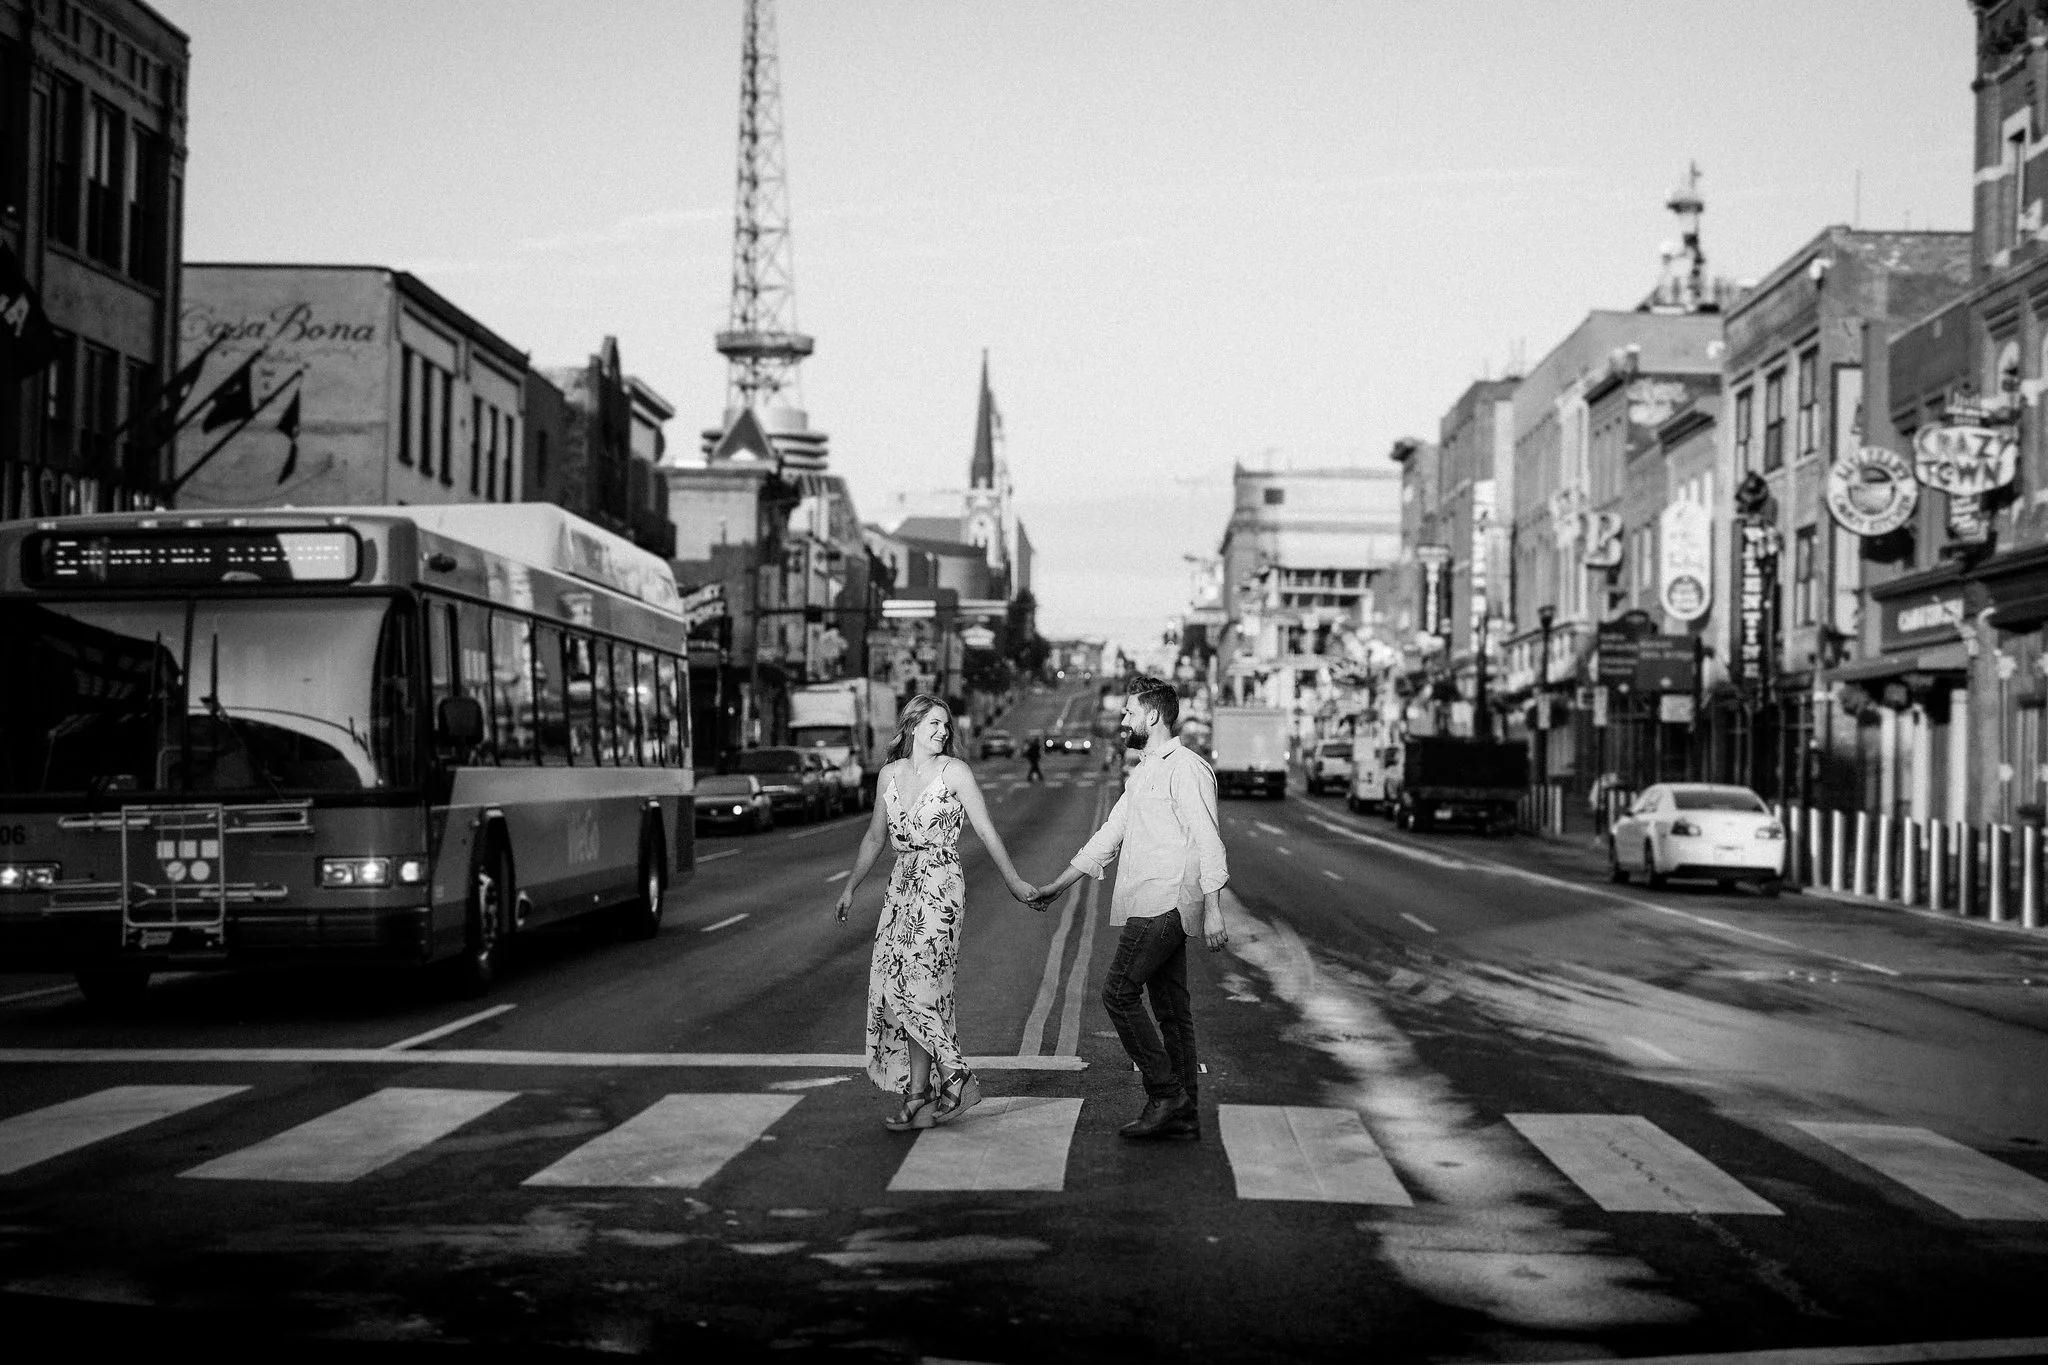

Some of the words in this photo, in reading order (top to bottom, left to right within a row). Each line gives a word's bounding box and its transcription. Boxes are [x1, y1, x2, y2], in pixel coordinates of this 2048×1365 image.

[269, 302, 375, 342] Bona
[1917, 425, 2014, 458] CRAZY
[1918, 460, 2003, 486] TOWN
